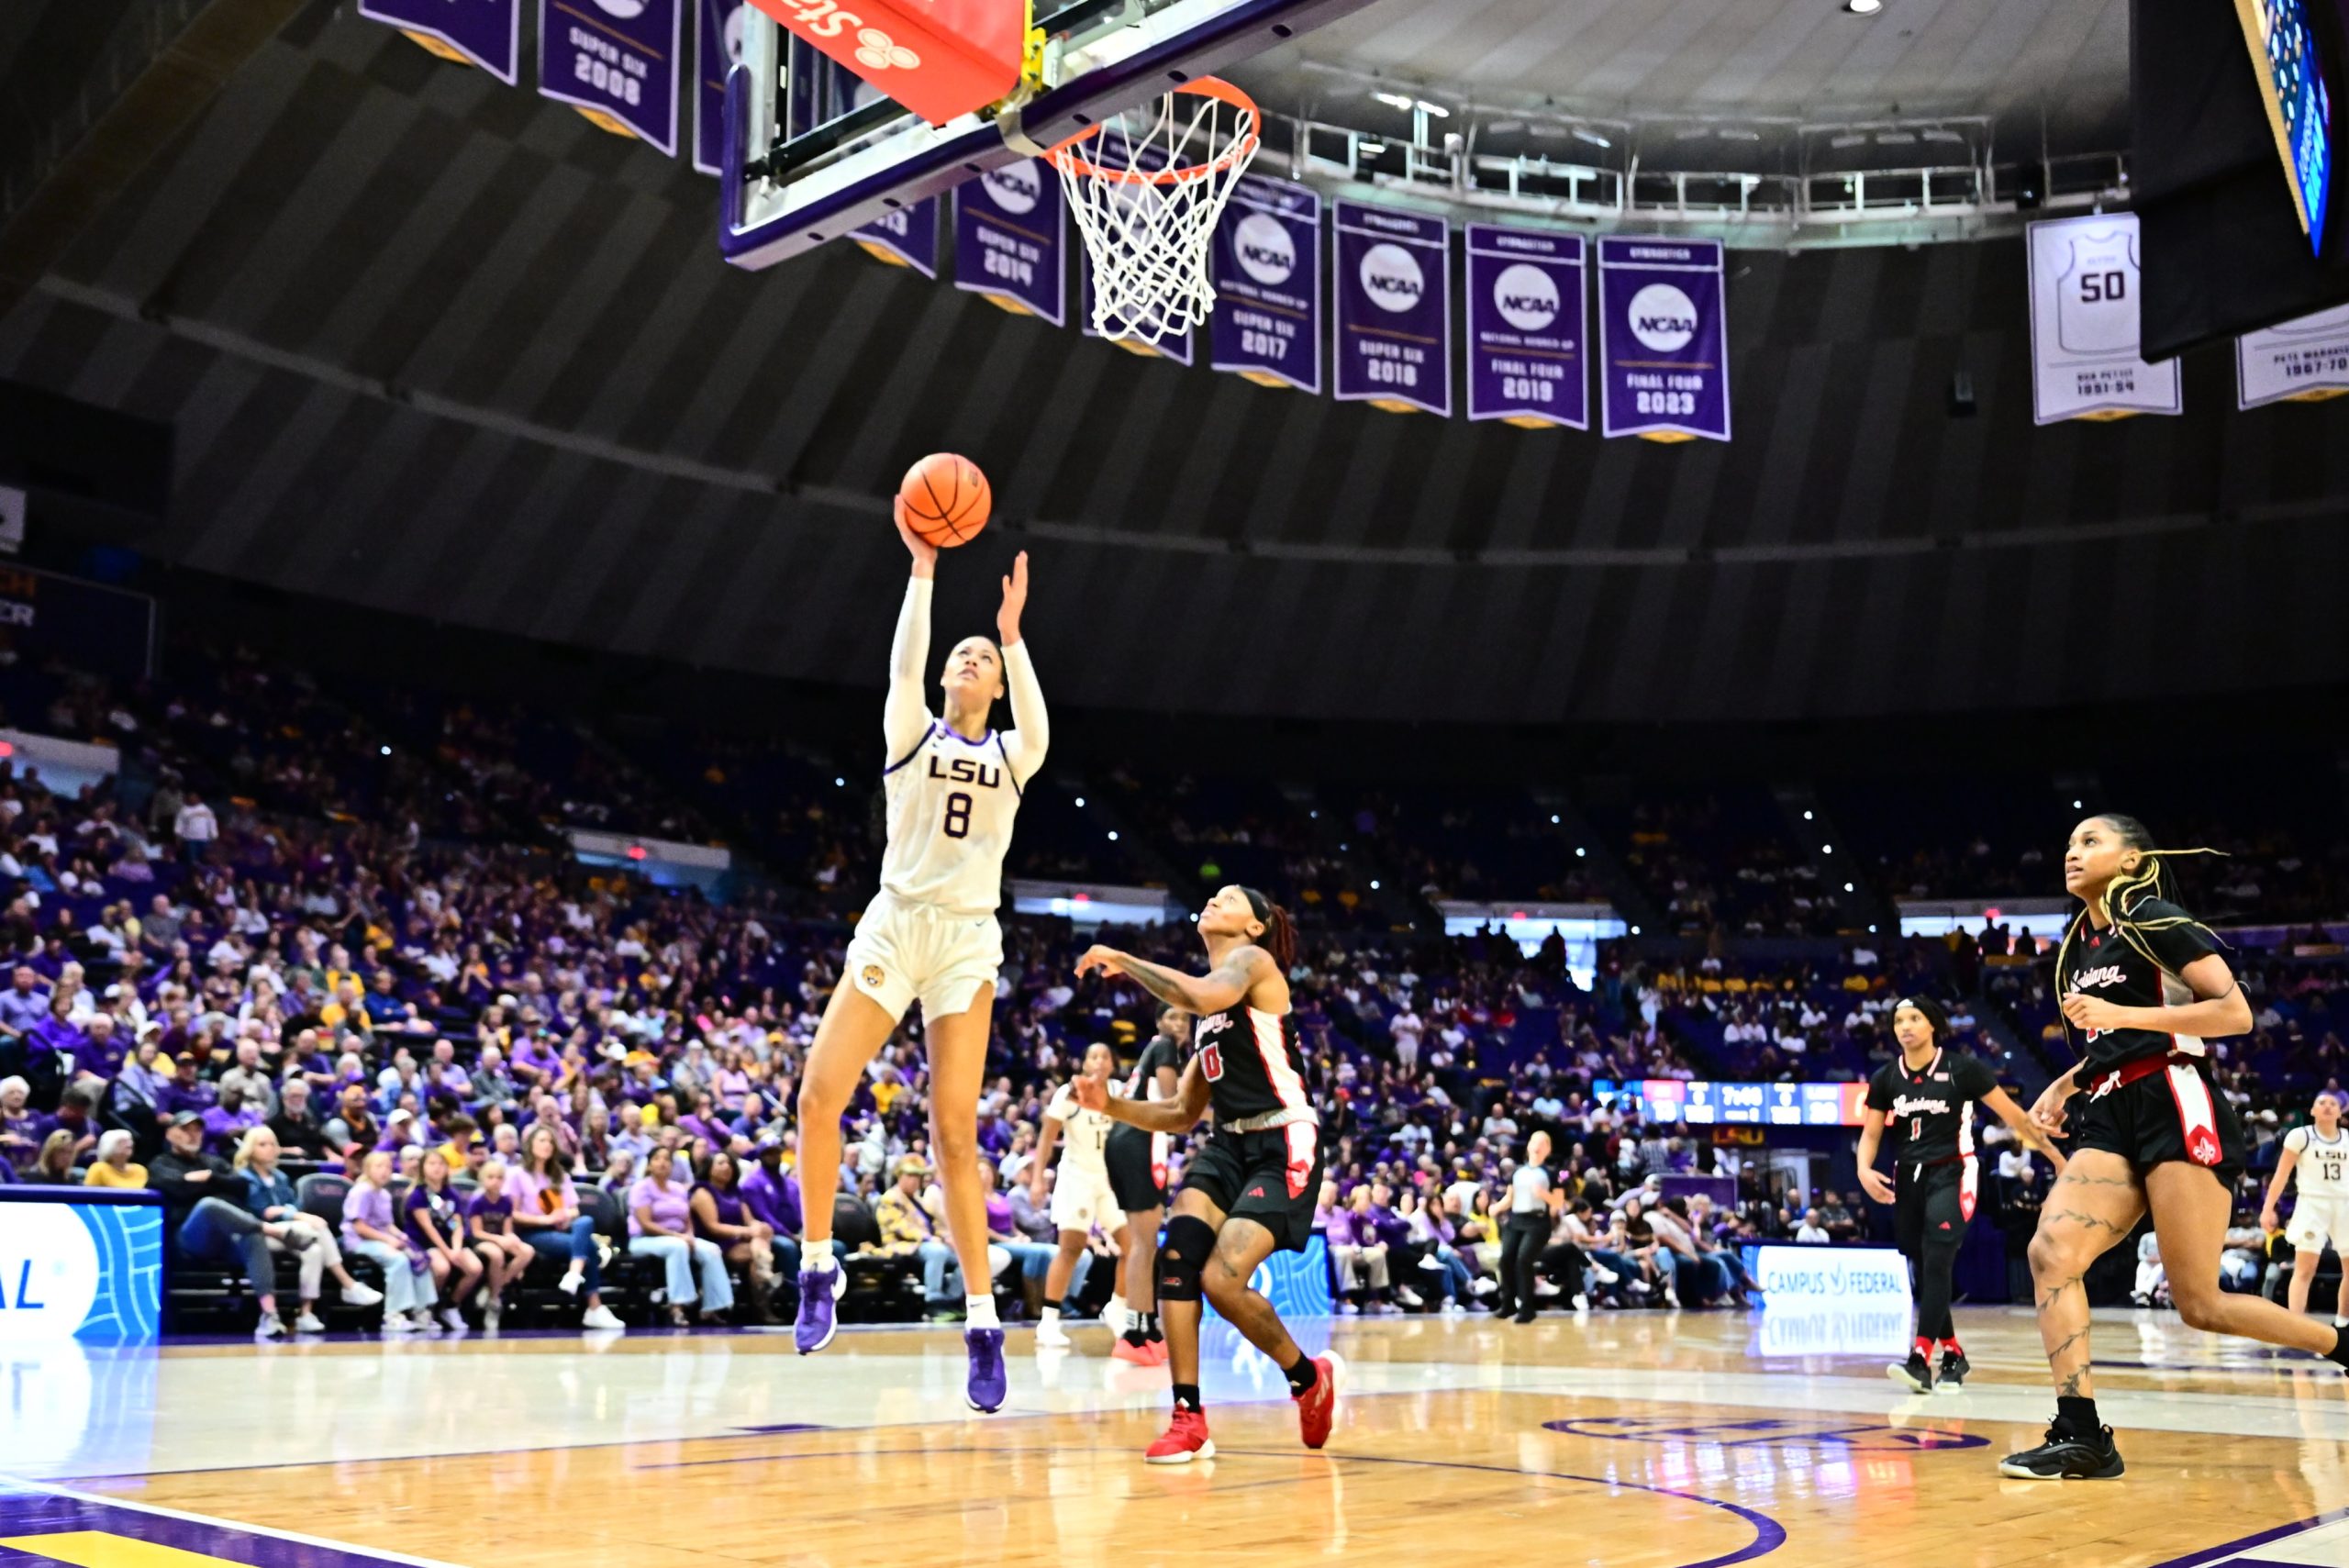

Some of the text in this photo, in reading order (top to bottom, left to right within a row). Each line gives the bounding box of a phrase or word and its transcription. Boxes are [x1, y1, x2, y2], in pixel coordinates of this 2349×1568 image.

[574, 52, 640, 106] 2008
[1243, 243, 1292, 269] NCAA
[1369, 273, 1420, 296] NCAA
[2081, 271, 2125, 303] 50
[1503, 294, 1557, 314] NCAA
[1638, 317, 1696, 333] NCAA
[1241, 328, 1287, 361] 2017
[1367, 358, 1418, 386] 2018
[1491, 358, 1565, 381] FINAL FOUR
[1626, 373, 1704, 391] FINAL FOUR
[1503, 375, 1553, 403] 2019
[1636, 391, 1695, 416] 2023
[929, 755, 999, 789] LSU
[943, 792, 973, 840] 8
[1198, 1040, 1224, 1083] 0
[1909, 1117, 1922, 1141] 1
[2315, 1150, 2347, 1162] LSU
[2323, 1162, 2341, 1181] 13
[1767, 1271, 1902, 1295] CAMPUS FEDERAL
